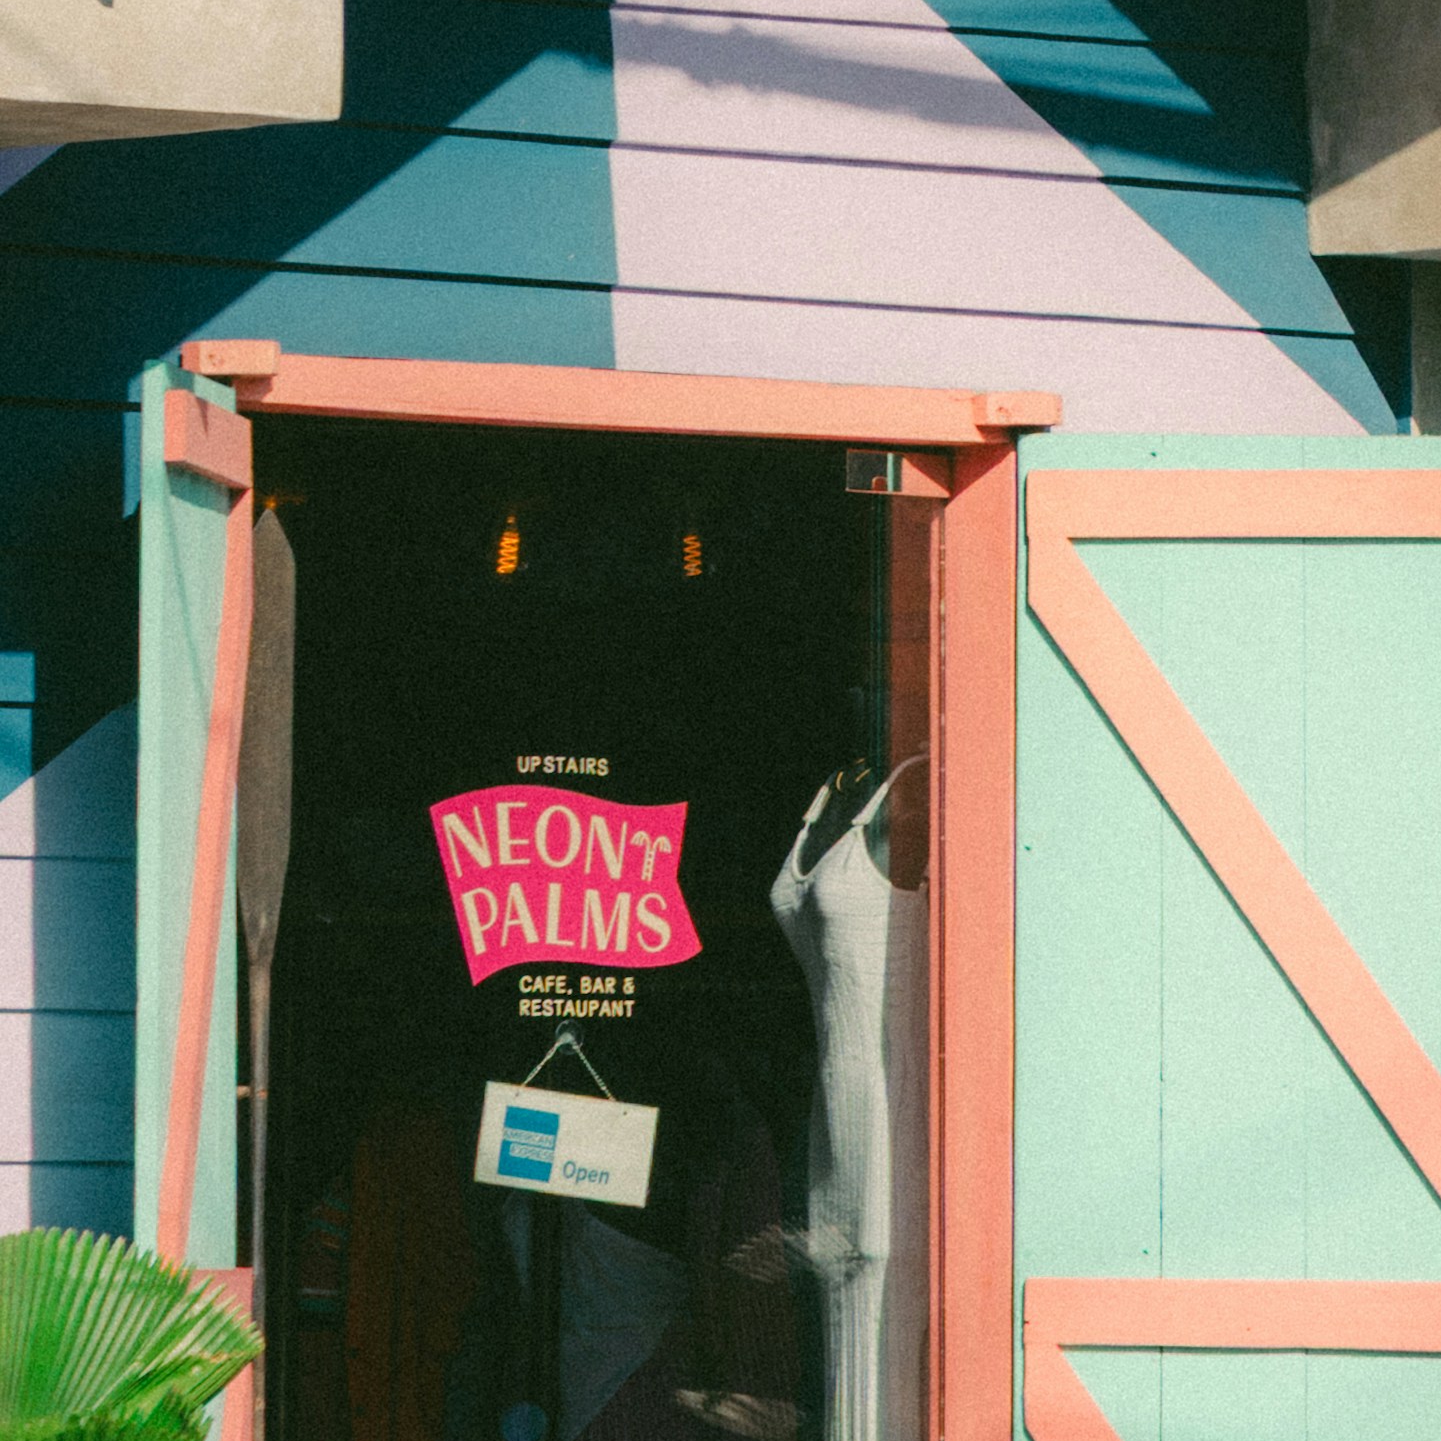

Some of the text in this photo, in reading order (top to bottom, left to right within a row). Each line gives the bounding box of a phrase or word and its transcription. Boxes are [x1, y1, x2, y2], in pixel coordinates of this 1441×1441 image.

[442, 802, 628, 879] NEON
[461, 882, 671, 955] PALMS
[519, 975, 636, 995] CAFE, BAR &
[562, 1160, 610, 1184] Open
